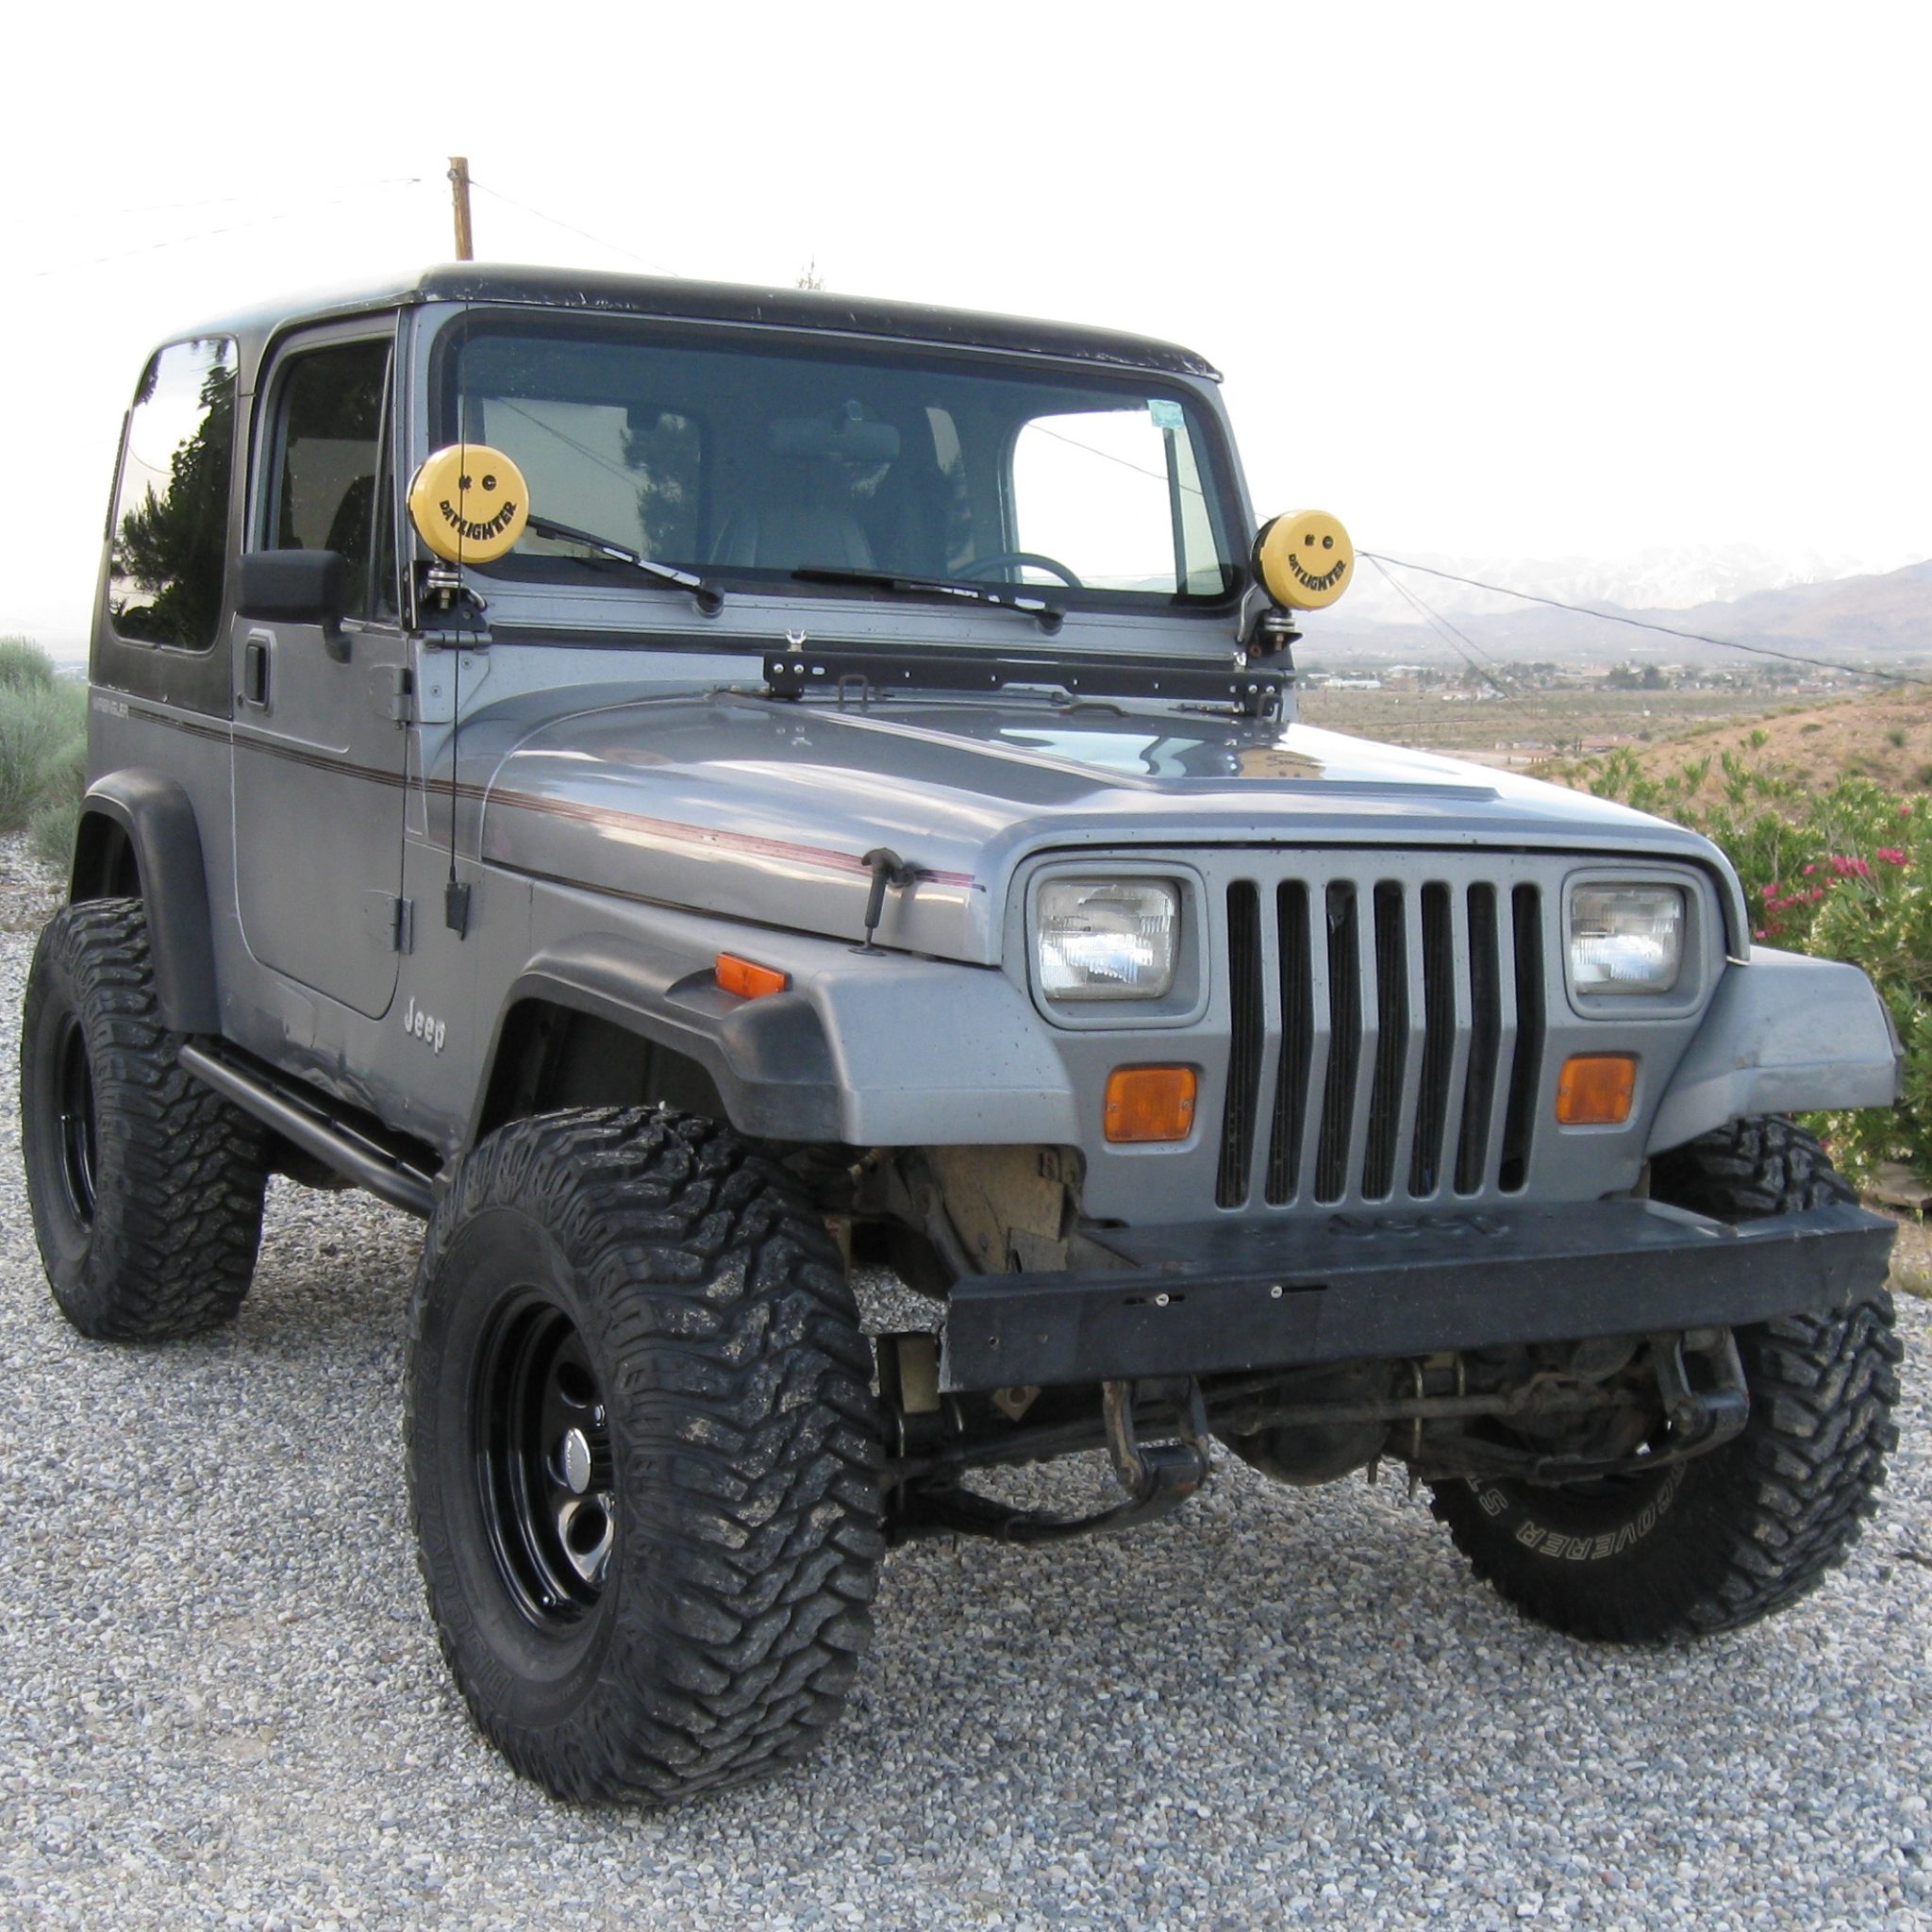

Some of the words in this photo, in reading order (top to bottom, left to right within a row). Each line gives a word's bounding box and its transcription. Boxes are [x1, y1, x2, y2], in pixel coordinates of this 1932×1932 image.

[440, 500, 517, 541] DAYLIGHTER
[1289, 554, 1347, 592] DAYLIGHTER
[404, 996, 445, 1054] Jeep
